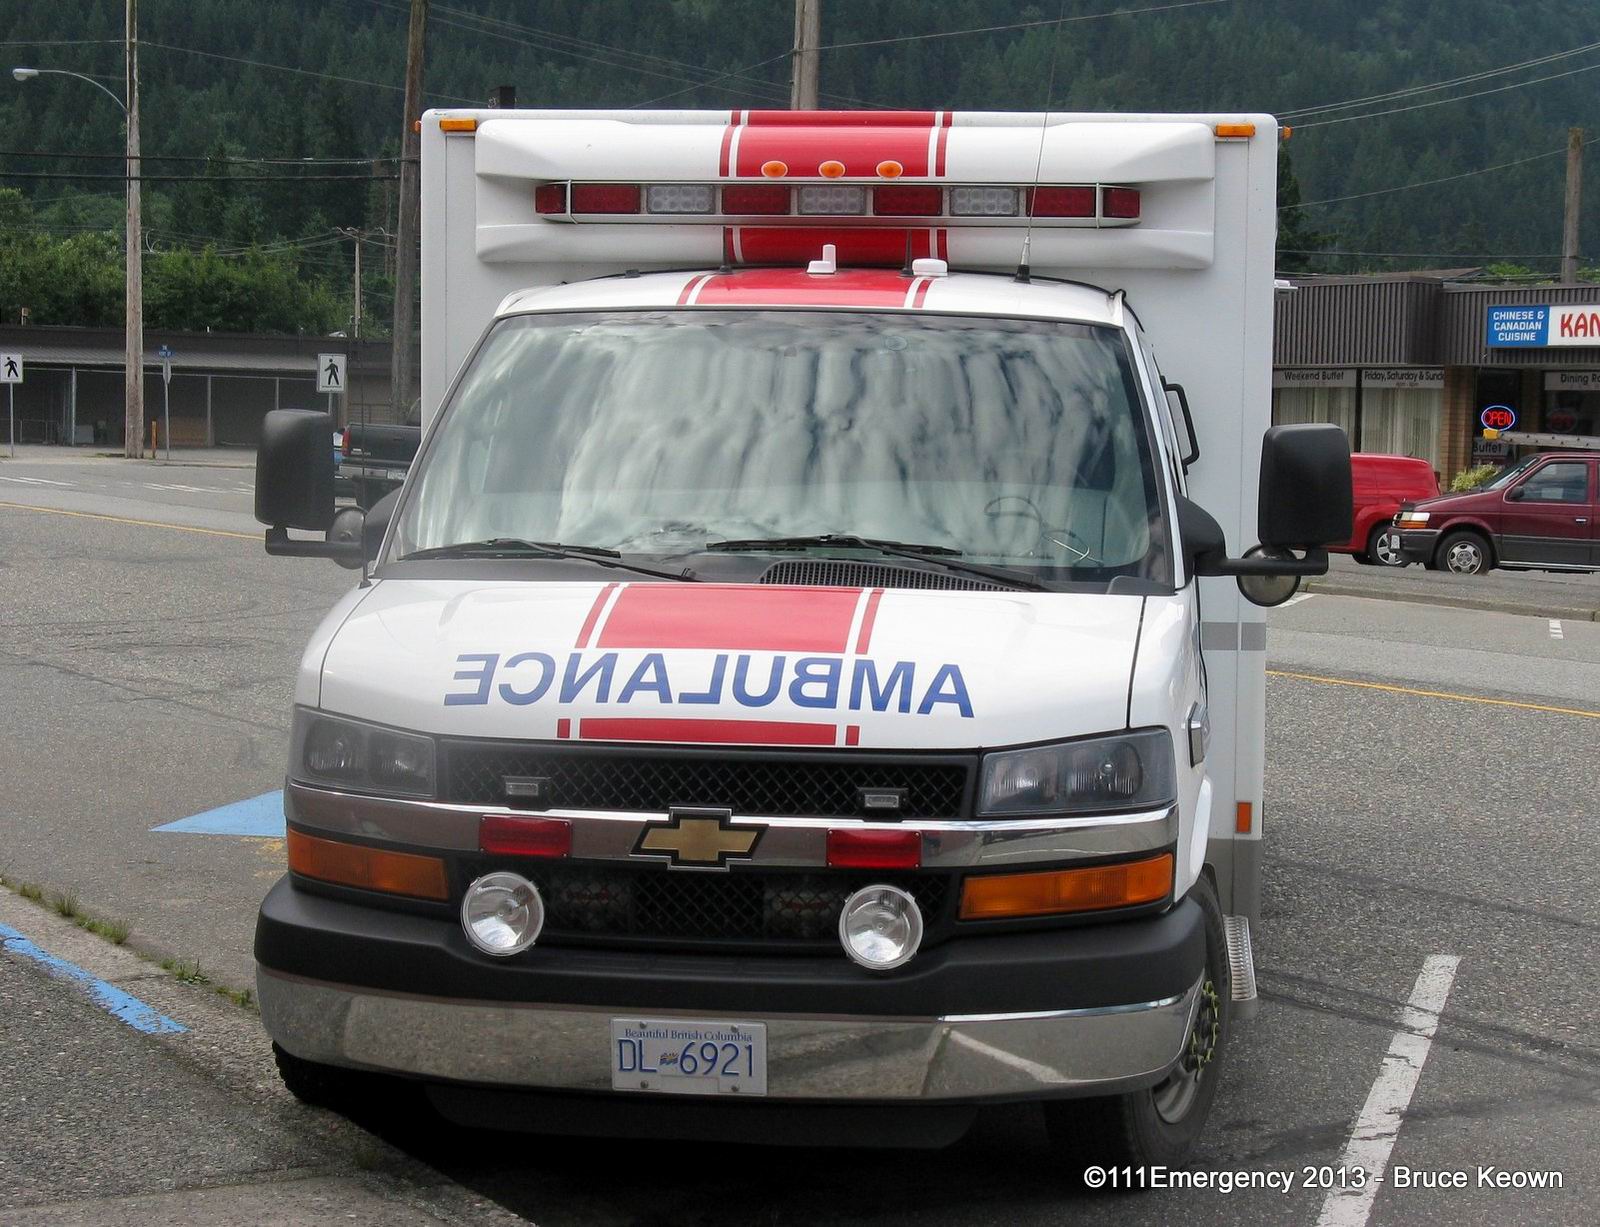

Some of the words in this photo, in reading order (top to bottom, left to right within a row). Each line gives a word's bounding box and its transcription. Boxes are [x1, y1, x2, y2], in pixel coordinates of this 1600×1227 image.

[1493, 311, 1534, 320] CHINESE
[1537, 311, 1545, 319] &
[1494, 321, 1542, 331] CANADIAN
[1498, 332, 1536, 341] CUISINE
[1284, 371, 1320, 380] Weekend
[1321, 371, 1344, 380] Buffet
[1387, 371, 1417, 382] Saturday
[1560, 373, 1589, 385] Dining
[1484, 411, 1512, 426] OPEN
[625, 1028, 669, 1040] Beautiful
[671, 1030, 702, 1041] British
[704, 1032, 753, 1042] Columbia
[618, 1038, 657, 1073] DL
[679, 1041, 753, 1078] 6921
